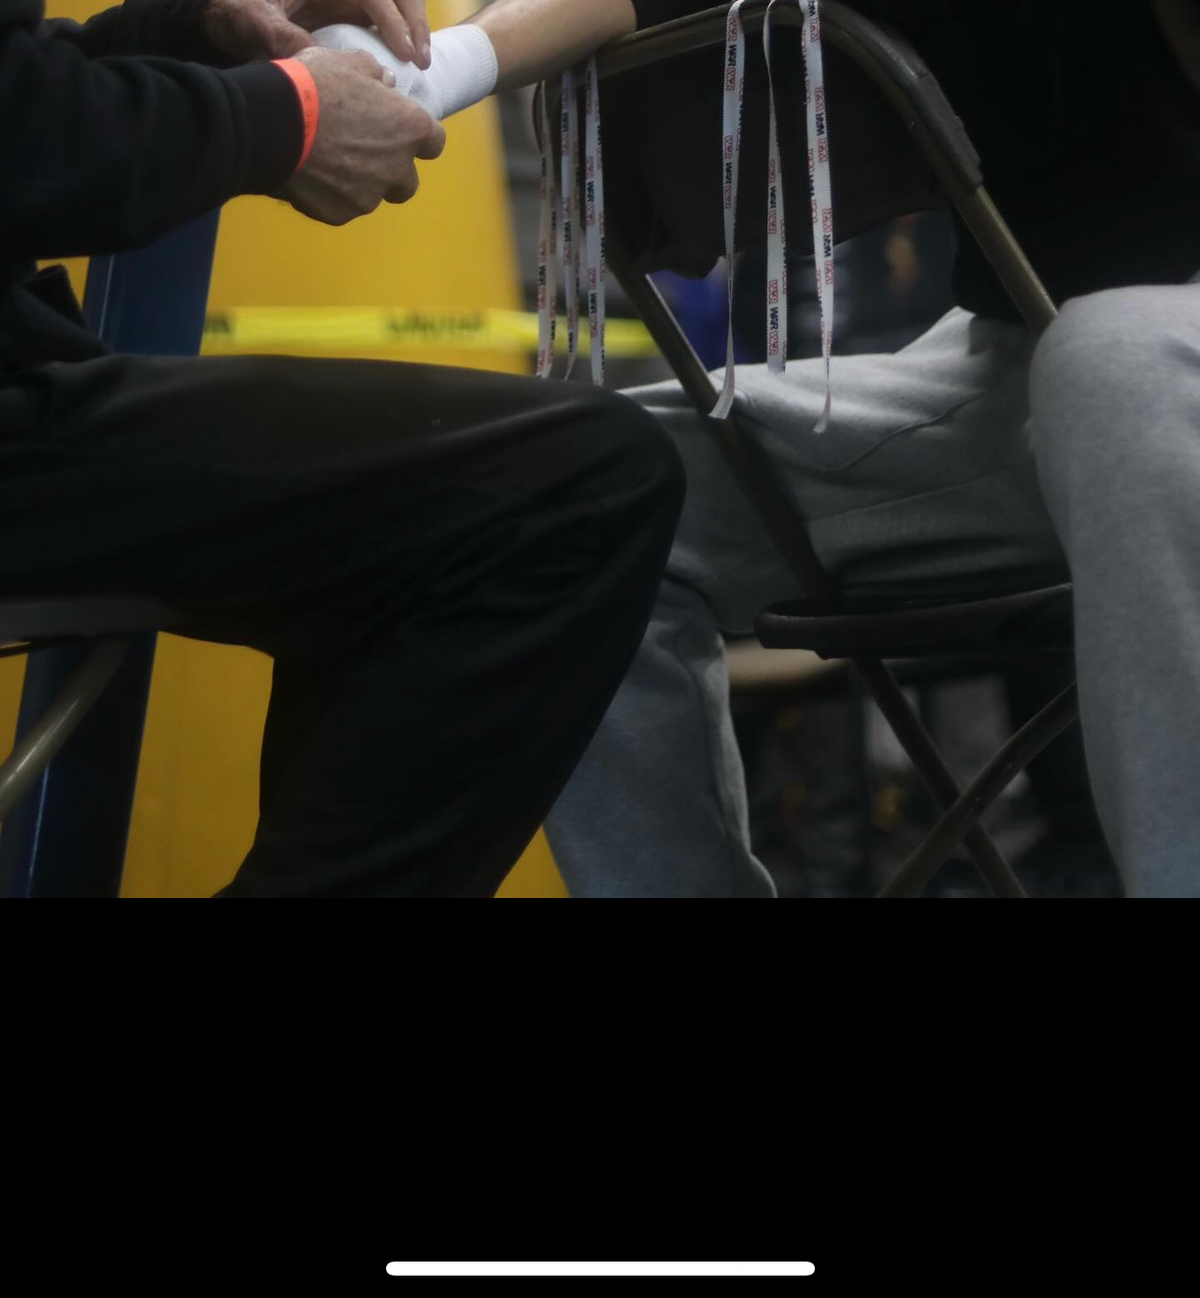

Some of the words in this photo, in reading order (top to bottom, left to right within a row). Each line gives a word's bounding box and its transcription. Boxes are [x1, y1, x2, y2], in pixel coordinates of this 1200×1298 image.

[728, 44, 737, 68] WAR
[562, 111, 570, 133] WAR
[816, 112, 825, 136] WAR
[725, 162, 733, 185] WAR
[587, 180, 595, 203] WAR
[769, 185, 777, 209] WAR
[823, 234, 832, 258] WAR
[539, 265, 547, 287] WAR
[590, 291, 598, 315] WAR
[770, 306, 778, 330] WAR
